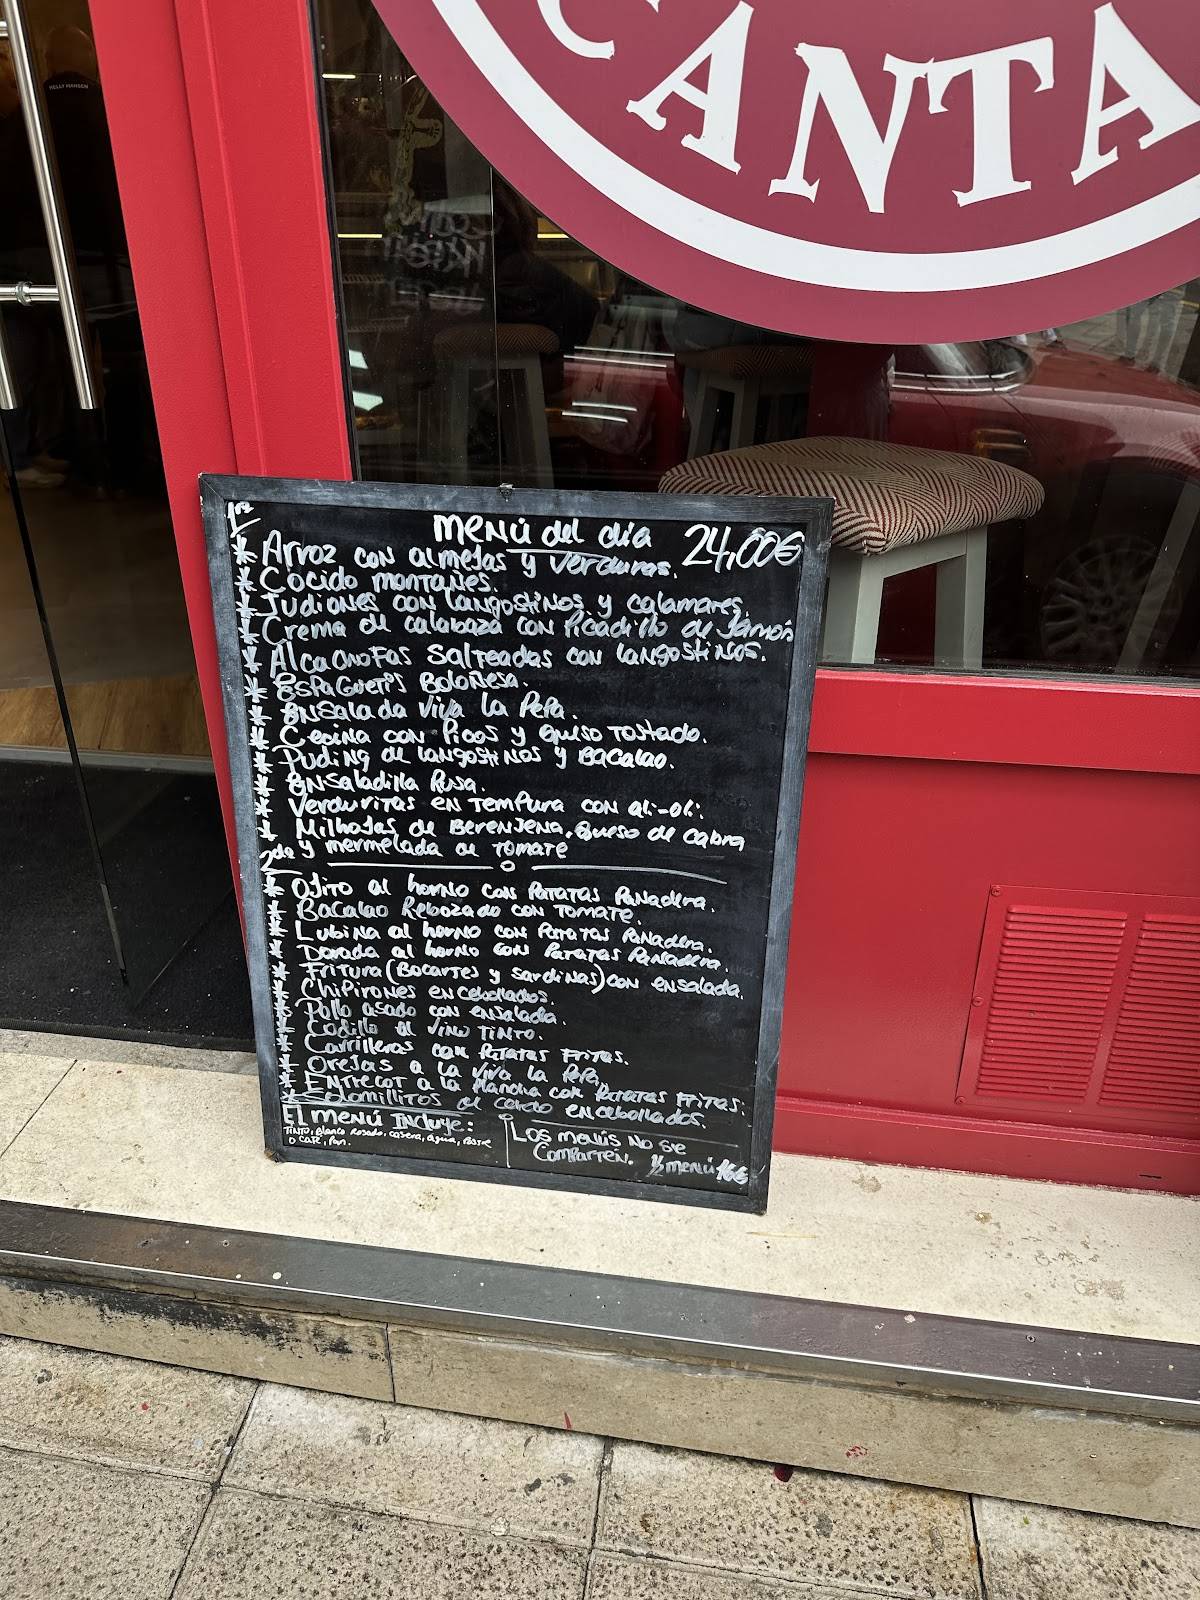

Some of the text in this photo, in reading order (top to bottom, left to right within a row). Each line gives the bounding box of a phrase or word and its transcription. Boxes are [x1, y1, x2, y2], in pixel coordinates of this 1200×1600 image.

[262, 529, 337, 570] Arroz
[409, 544, 507, 572] almejas
[521, 552, 536, 578] y
[541, 517, 585, 547] del
[682, 524, 805, 573] 24,00€
[260, 566, 358, 593] Cocido
[255, 592, 380, 618] Judiones
[597, 594, 612, 619] y
[262, 616, 346, 645] Crema
[481, 692, 508, 717] la
[511, 726, 526, 746] y
[554, 746, 566, 769] y
[298, 840, 316, 859] y
[368, 878, 391, 896] al
[297, 900, 389, 922] Bacalao
[295, 921, 381, 941] Lubina
[388, 924, 412, 939] al
[296, 943, 379, 961] Dorada
[391, 943, 414, 959] al
[489, 967, 501, 984] y
[295, 999, 352, 1021] Pollo
[362, 1001, 417, 1018] asado
[394, 1021, 417, 1036] al
[307, 1055, 394, 1073] Orejas
[410, 1061, 424, 1075] a
[437, 1060, 462, 1079] la
[527, 1064, 549, 1082] la
[417, 1077, 434, 1091] a
[441, 1075, 460, 1092] la
